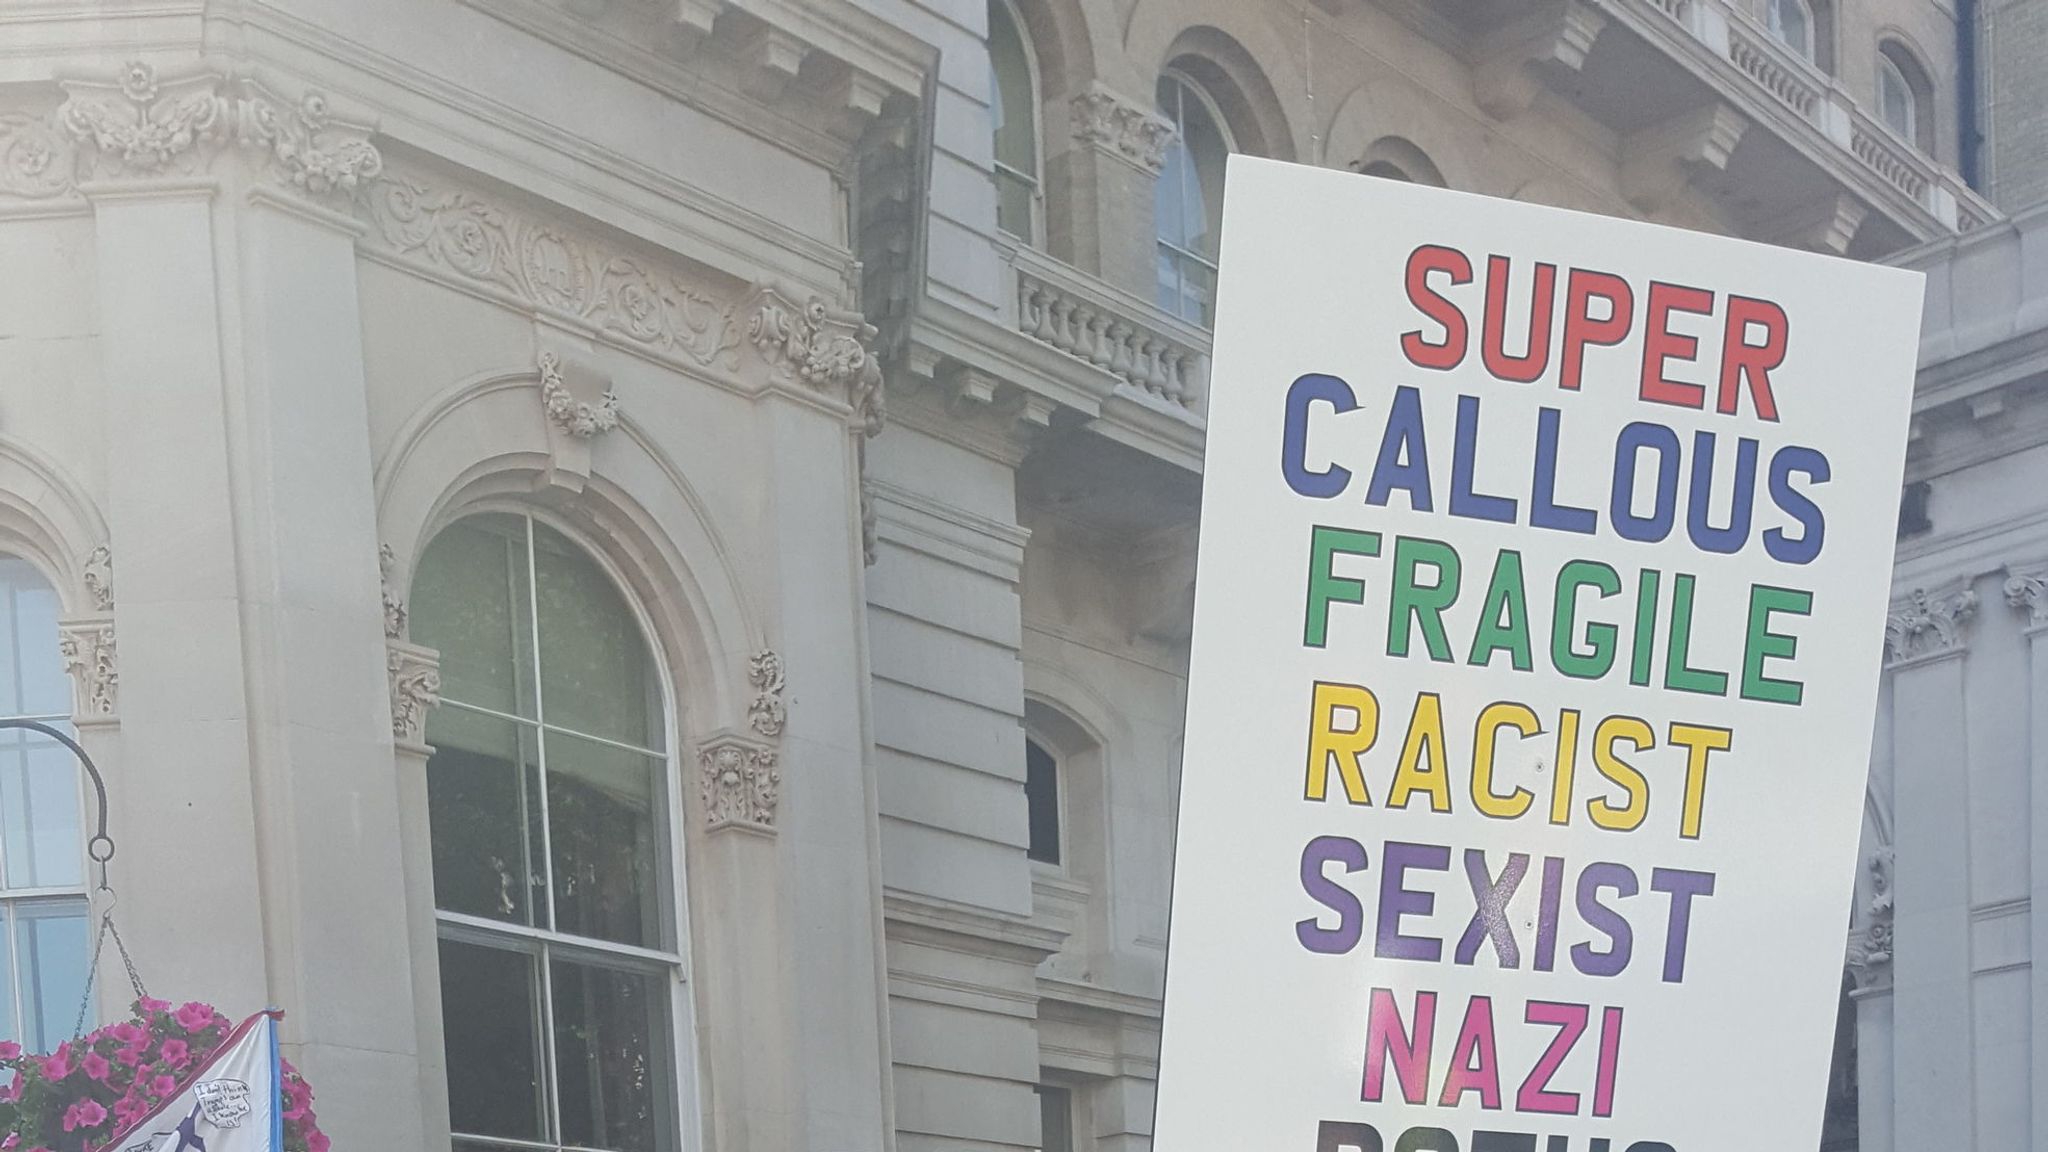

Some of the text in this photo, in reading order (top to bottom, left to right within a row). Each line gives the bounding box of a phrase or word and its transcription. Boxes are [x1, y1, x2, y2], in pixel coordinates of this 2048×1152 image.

[1400, 243, 1789, 423] SUPER
[1281, 372, 1831, 565] CALLOUS
[1303, 524, 1814, 707] FRAGILE
[1303, 679, 1734, 840] RACIST
[1295, 835, 1716, 984] SEXIST
[196, 1084, 206, 1096] I
[1360, 988, 1624, 1118] NAZI
